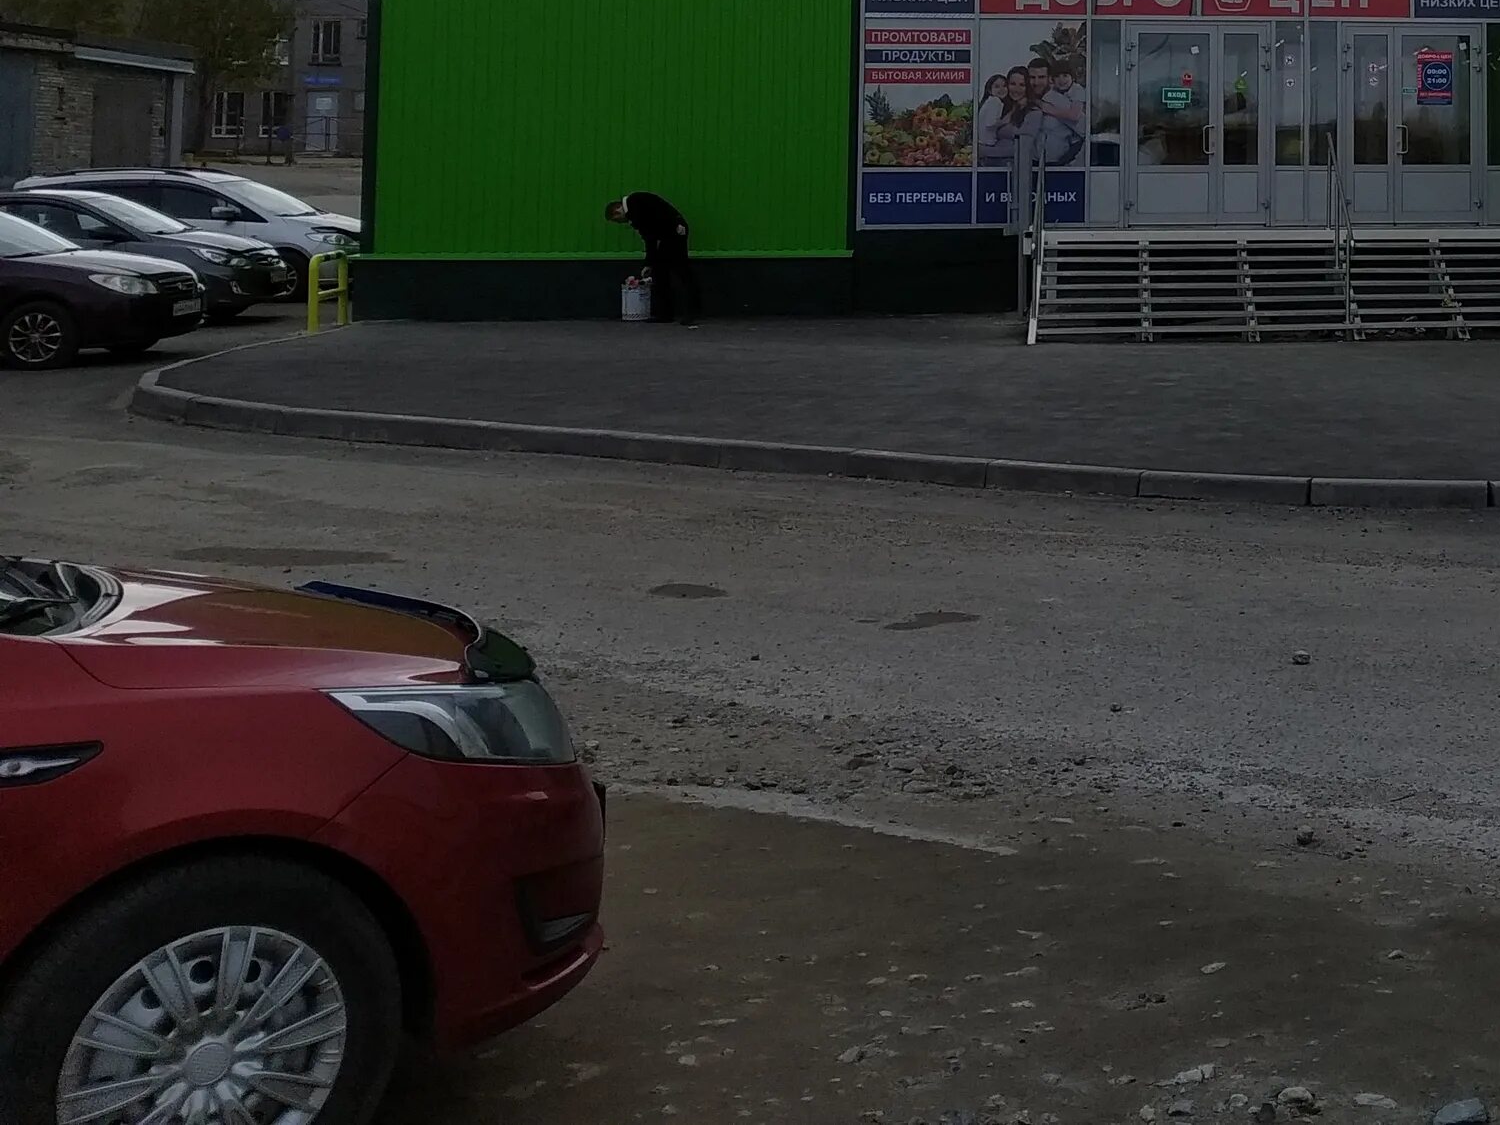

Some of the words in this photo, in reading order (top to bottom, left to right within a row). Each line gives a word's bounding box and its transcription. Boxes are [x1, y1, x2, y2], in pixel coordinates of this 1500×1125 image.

[871, 31, 966, 43] ПРОМТОВАРЫ
[882, 50, 955, 63] ПРОДУКТЫ
[871, 71, 922, 80] БЫТОВАЯ
[925, 71, 965, 80] ХИМИЯ
[1167, 91, 1187, 99] ВХОД
[868, 192, 892, 203] БЕЗ
[896, 192, 964, 203] ПЕРЕРЫВА
[985, 192, 995, 203] И
